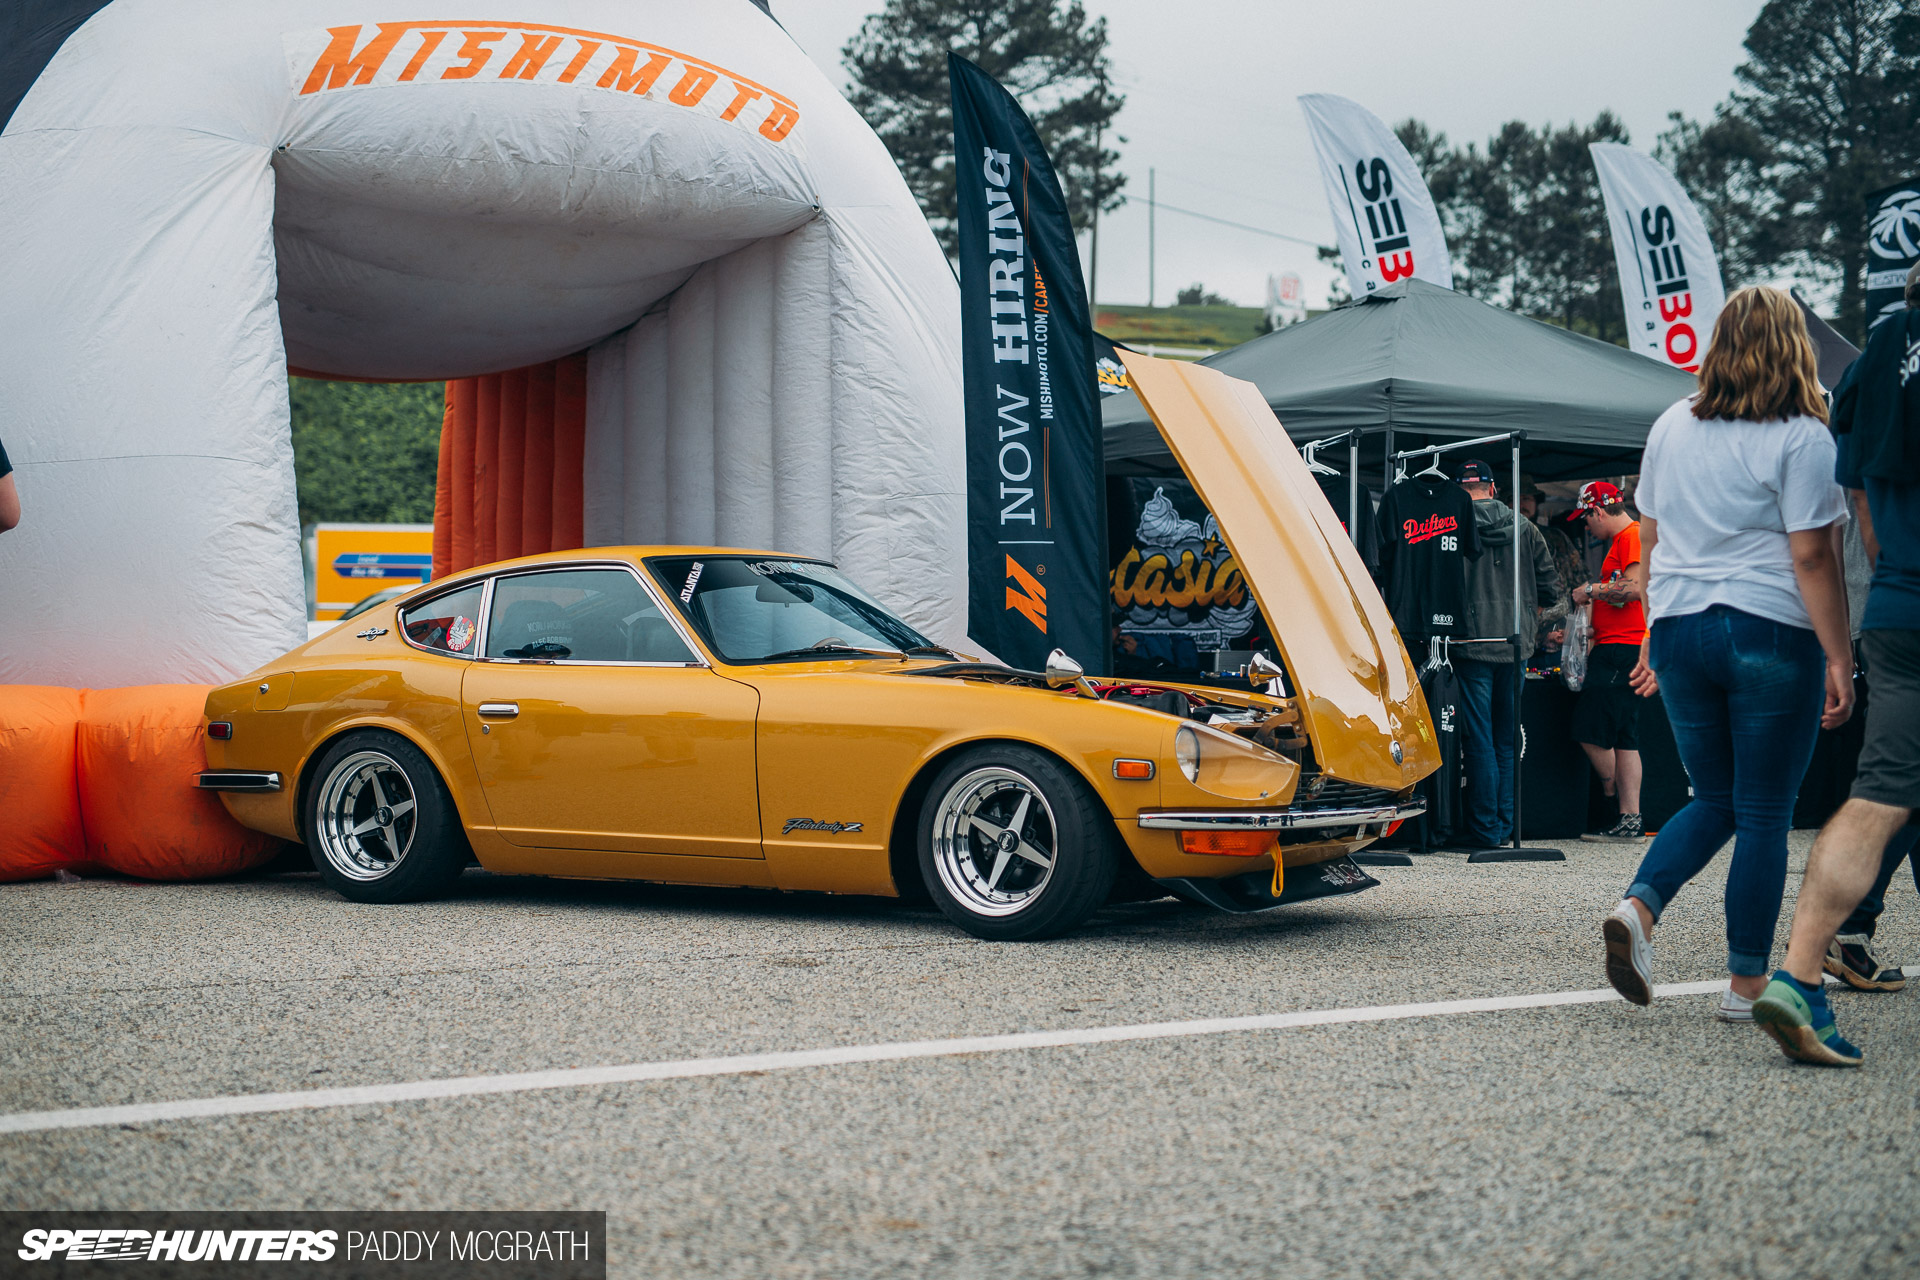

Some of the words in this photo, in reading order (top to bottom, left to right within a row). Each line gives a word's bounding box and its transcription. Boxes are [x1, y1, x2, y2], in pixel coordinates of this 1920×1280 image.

[300, 20, 800, 143] MISHIMOTO
[983, 147, 1030, 365] HIRING
[996, 384, 1036, 526] NOW
[1403, 513, 1458, 541] Drifters
[1441, 535, 1458, 551] 86
[1110, 544, 1245, 608] tasia
[782, 818, 844, 835] Fairlady
[844, 822, 864, 832] Z
